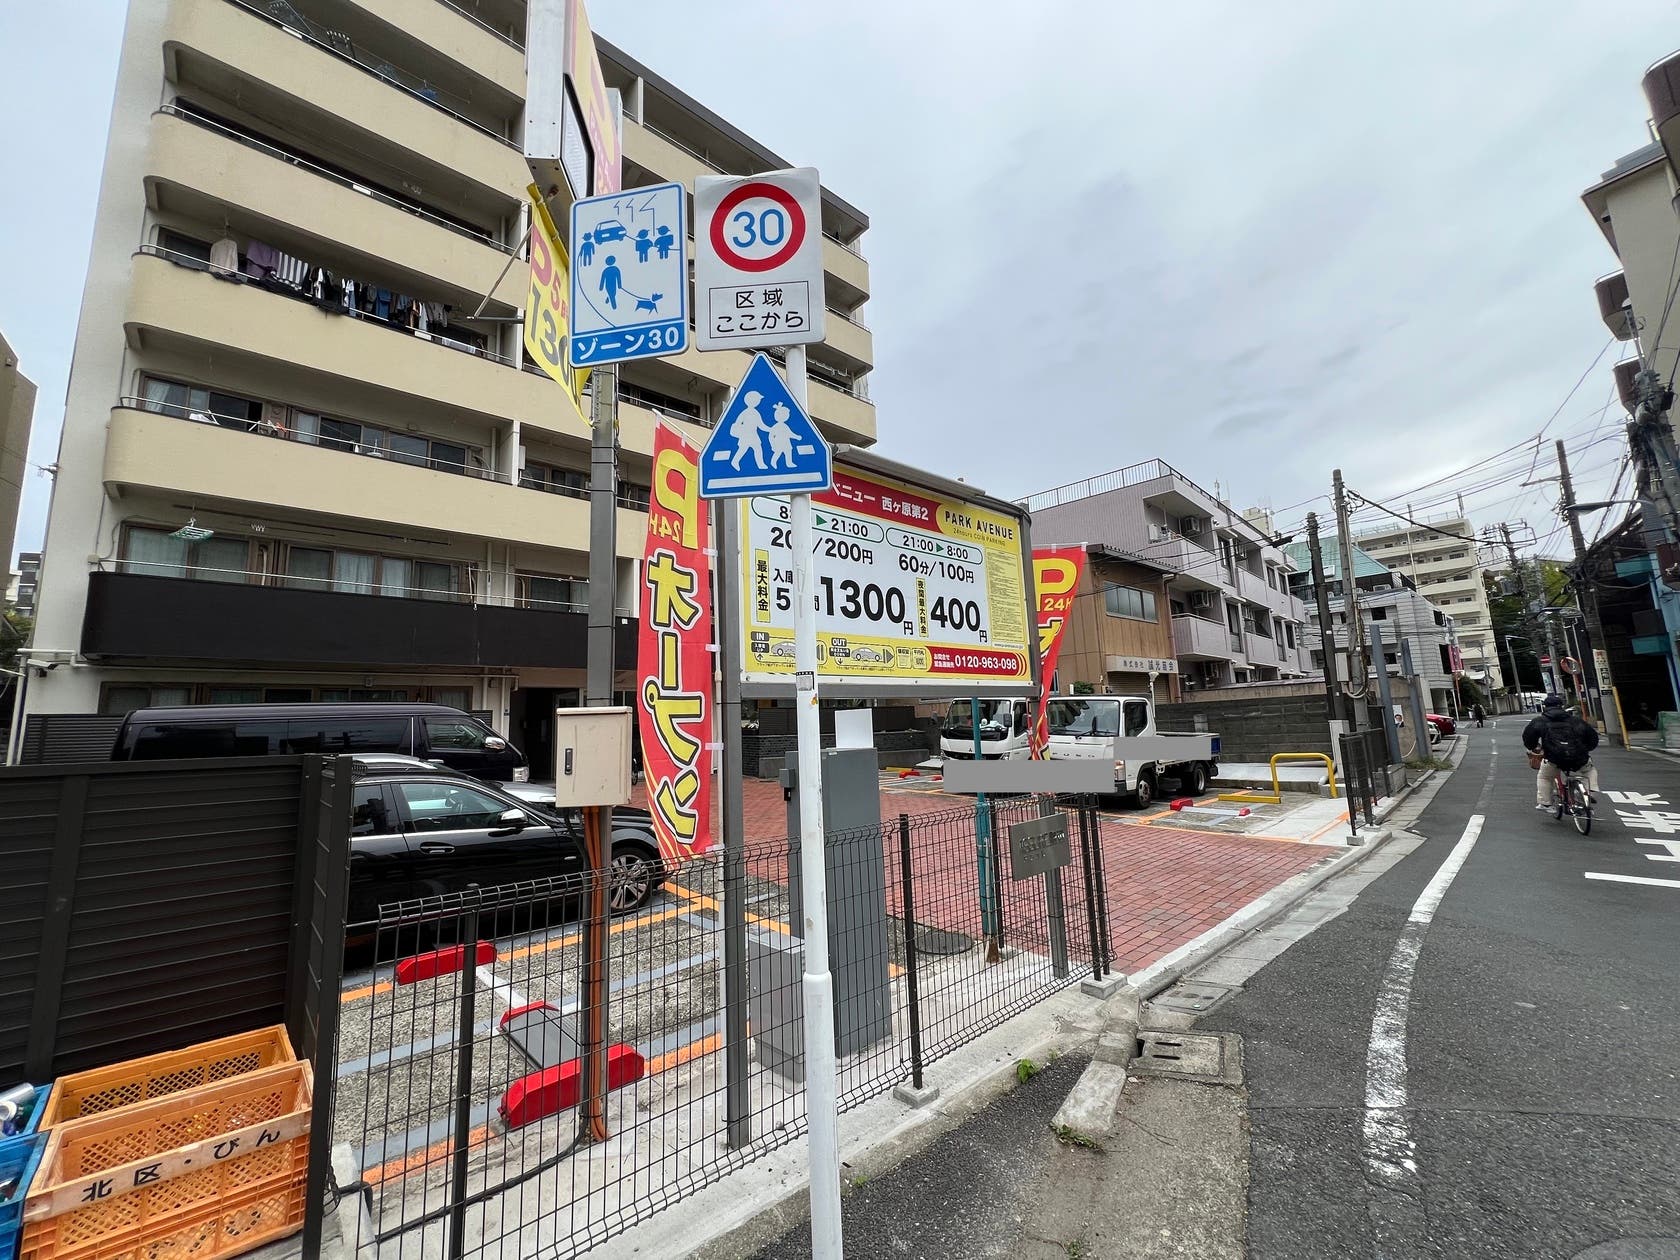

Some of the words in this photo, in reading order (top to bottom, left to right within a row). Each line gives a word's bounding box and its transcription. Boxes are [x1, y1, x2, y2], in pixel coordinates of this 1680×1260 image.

[732, 208, 785, 249] 30
[735, 287, 784, 309] 区域
[716, 310, 804, 334] ここから
[578, 327, 679, 360] ゾーン30
[831, 517, 869, 538] 21:00
[945, 510, 972, 529] PARK
[977, 519, 1013, 540] AVENUE
[902, 534, 934, 553] 21:00
[946, 545, 969, 560] 8:00
[898, 553, 975, 584] 60分/100円
[756, 559, 769, 612] 最大料金
[1032, 558, 1078, 612] P
[756, 632, 765, 641] IN
[832, 638, 847, 647] OUT
[954, 654, 1018, 671] 0120-963-098
[82, 1128, 280, 1202] 北区・びん
